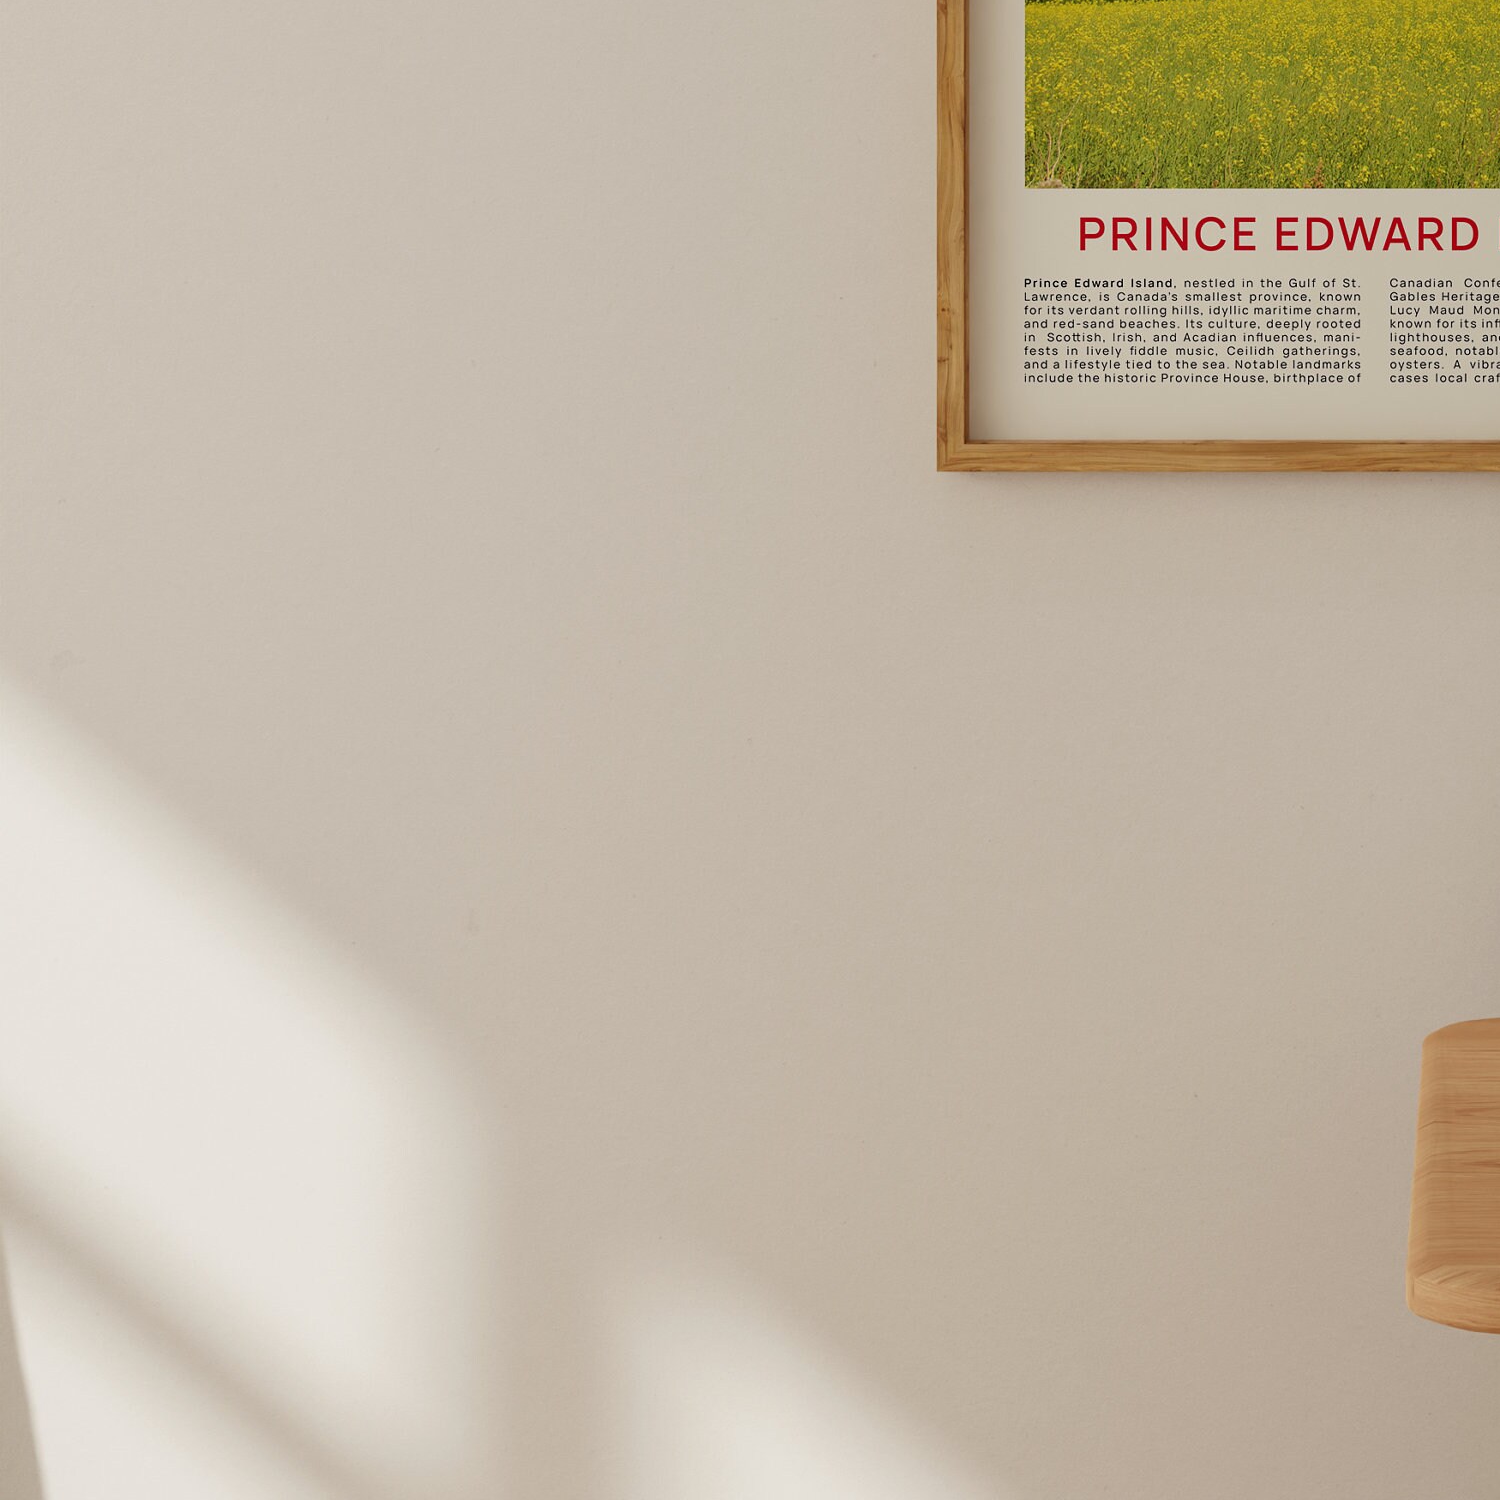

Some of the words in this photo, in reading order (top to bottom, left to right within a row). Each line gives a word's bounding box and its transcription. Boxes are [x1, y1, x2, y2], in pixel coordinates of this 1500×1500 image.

[1079, 216, 1257, 252] PRINCE
[1276, 216, 1479, 252] EDWARD
[1024, 277, 1068, 289] Prince
[1074, 277, 1124, 289] Edward
[1130, 277, 1177, 289] Island,
[1183, 278, 1235, 289] nestled
[1241, 278, 1254, 288] in
[1259, 278, 1283, 289] the
[1288, 277, 1317, 289] Gulf
[1322, 277, 1337, 289] of
[1342, 277, 1361, 289] St.
[1389, 277, 1453, 289] Canadian
[1024, 291, 1092, 303] Lawrence,
[1098, 291, 1110, 302] is
[1116, 291, 1178, 302] Canada's
[1184, 291, 1243, 302] smallest
[1249, 291, 1312, 305] province,
[1319, 291, 1361, 302] known
[1389, 291, 1436, 302] Gables
[1441, 291, 1500, 305] Heritage
[1023, 304, 1043, 316] for
[1047, 305, 1065, 316] its
[1068, 305, 1120, 316] verdant
[1124, 305, 1167, 318] rolling
[1171, 305, 1204, 316] hills,
[1208, 305, 1249, 318] idyllic
[1253, 305, 1312, 316] maritime
[1315, 305, 1361, 316] charm,
[1389, 305, 1421, 318] Lucy
[1429, 305, 1464, 316] Maud
[1023, 318, 1048, 329] and
[1053, 318, 1115, 330] red-sand
[1119, 318, 1180, 329] beaches.
[1185, 318, 1203, 329] Its
[1207, 318, 1261, 330] culture,
[1266, 318, 1312, 332] deeply
[1316, 318, 1361, 329] rooted
[1389, 318, 1432, 329] known
[1436, 318, 1455, 329] for
[1459, 318, 1477, 329] its
[1024, 332, 1036, 343] in
[1046, 331, 1106, 343] Scottish,
[1112, 332, 1146, 344] Irish,
[1152, 332, 1177, 343] and
[1182, 332, 1237, 343] Acadian
[1243, 331, 1317, 343] influences,
[1323, 332, 1361, 343] mani-
[1389, 332, 1474, 346] lighthouses,
